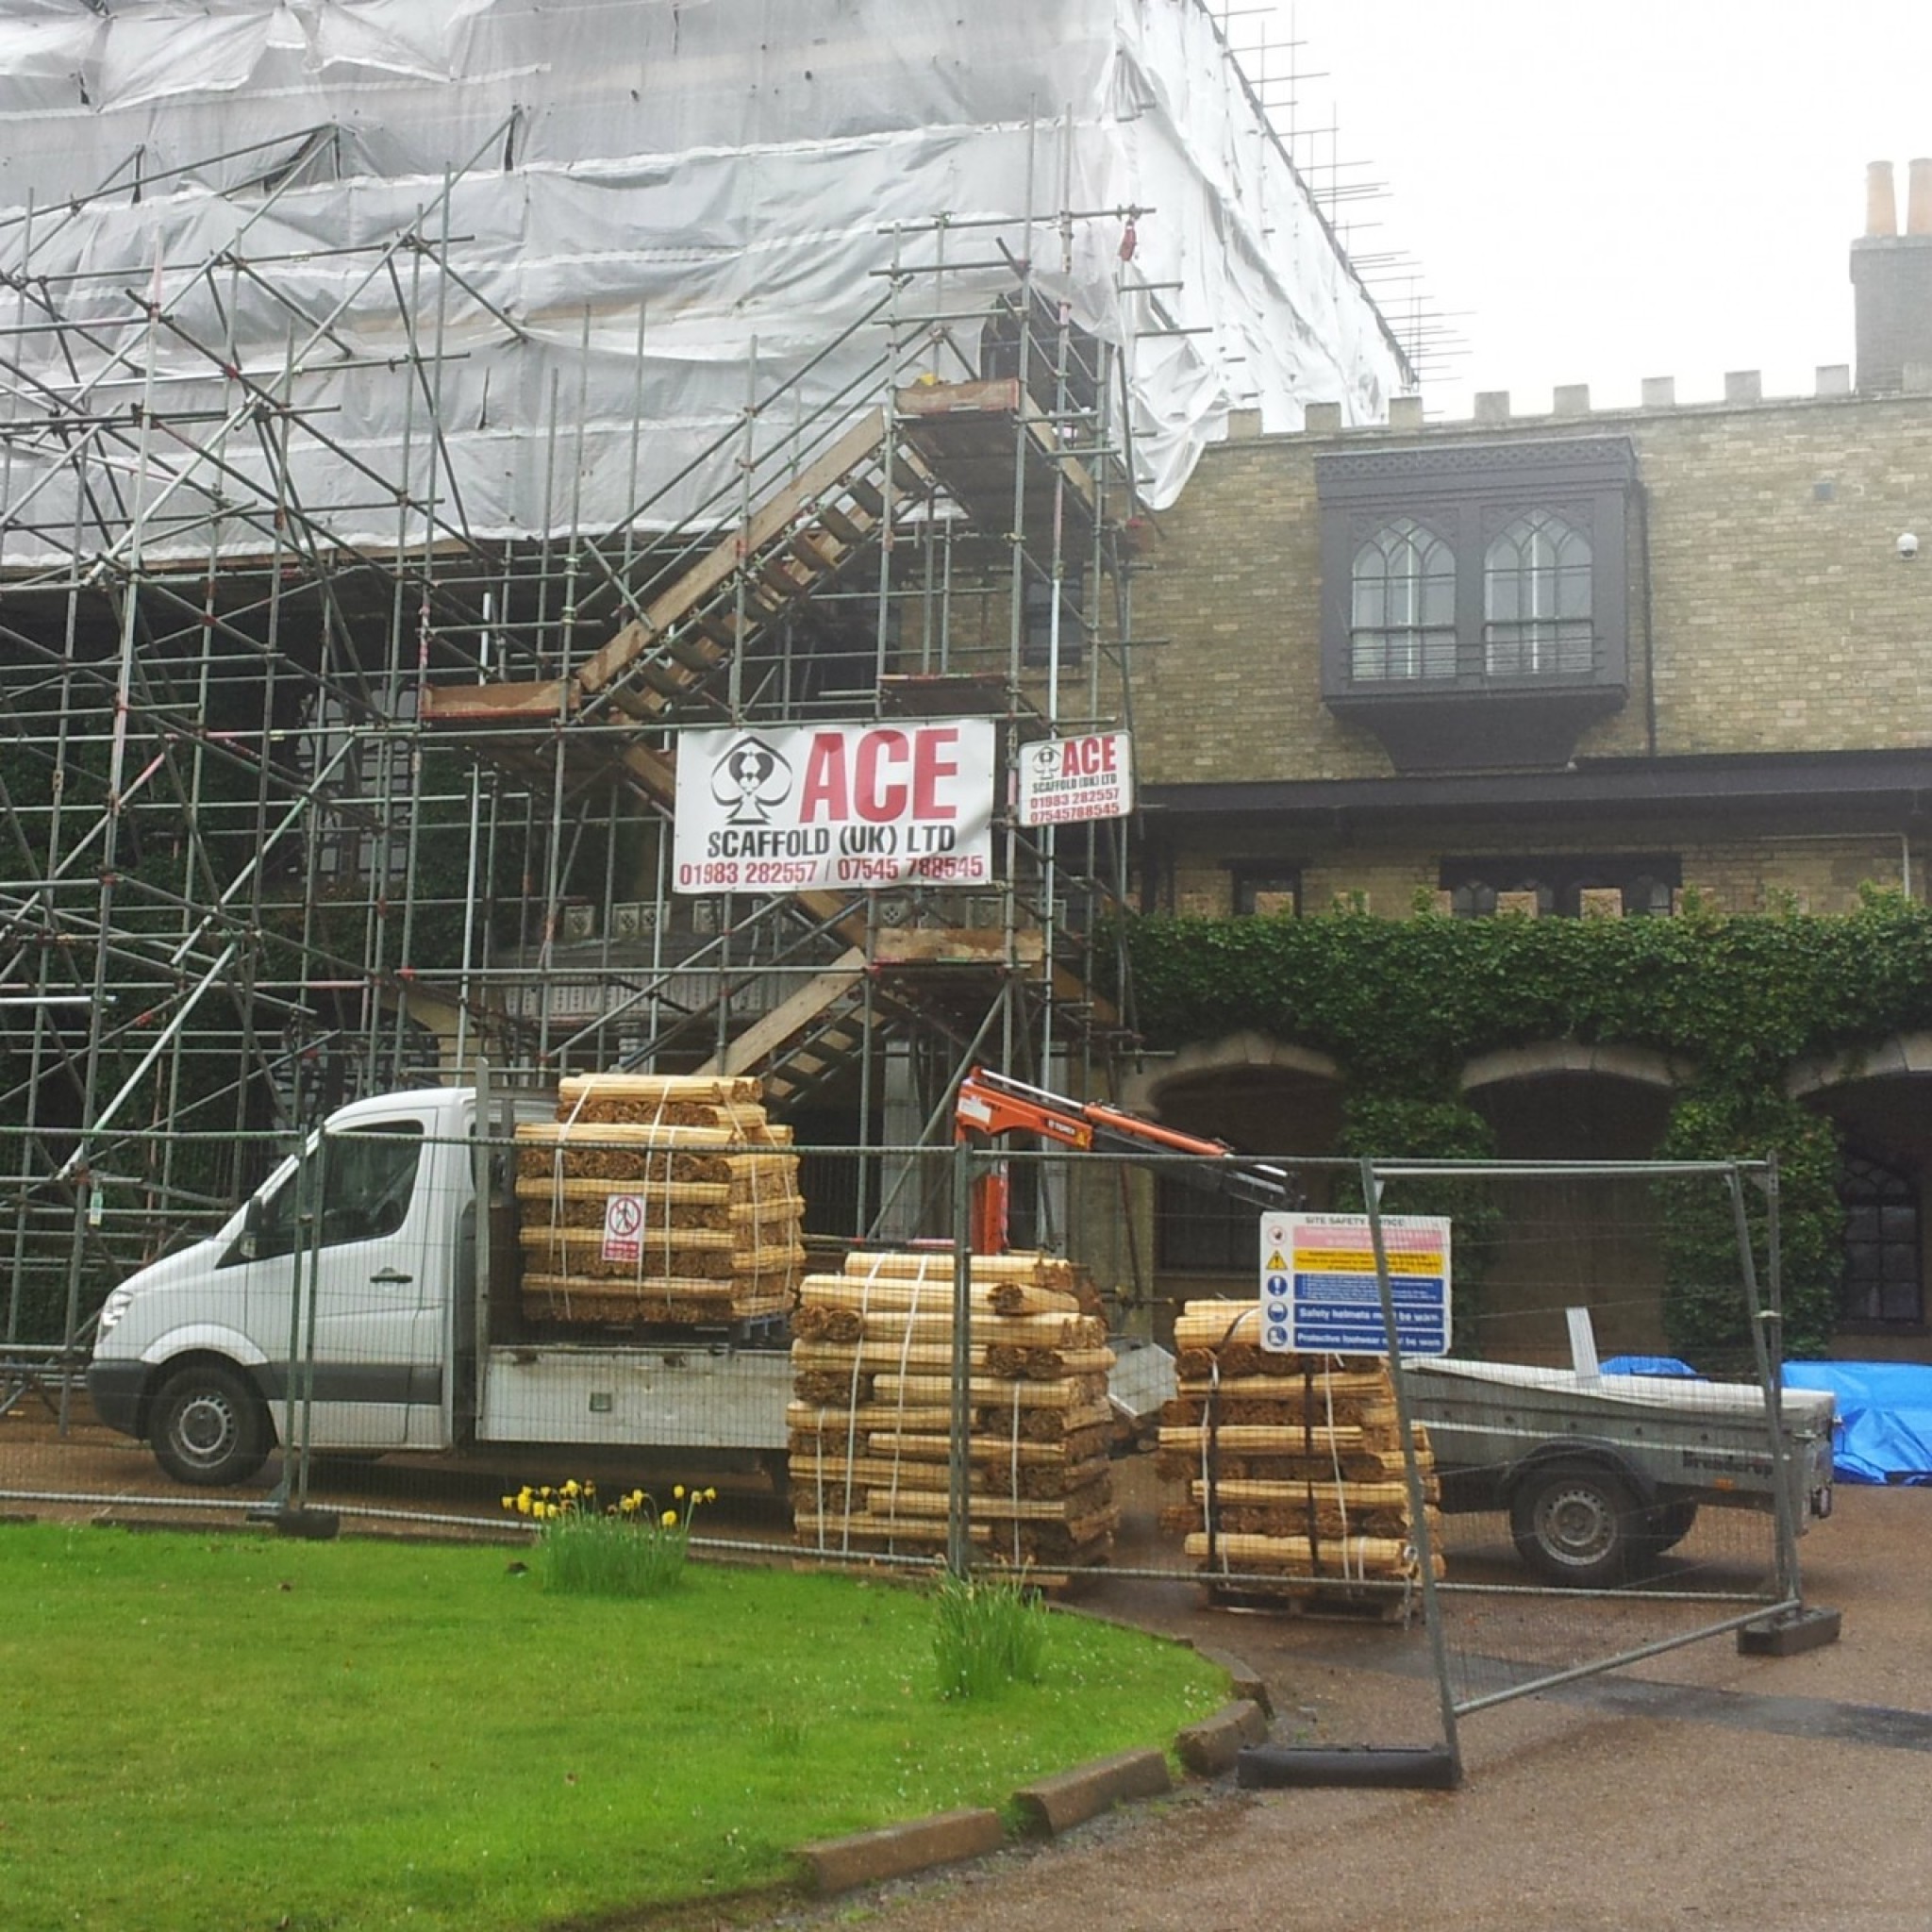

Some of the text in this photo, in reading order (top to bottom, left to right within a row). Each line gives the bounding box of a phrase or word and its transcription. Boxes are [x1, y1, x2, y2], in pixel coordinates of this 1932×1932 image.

[1061, 735, 1116, 777] ACE
[799, 727, 958, 824] ACE
[1032, 778, 1077, 793] SCAFFOLD
[1101, 774, 1117, 786] LTD
[1030, 788, 1120, 808] 01983 282557
[1030, 802, 1120, 824] 07545788545
[707, 825, 955, 858] SCAFFOLD (UK) LTD
[679, 861, 740, 886] 01983
[745, 859, 818, 883] 282557
[837, 857, 899, 881] 07545
[907, 855, 984, 879] 788545
[1305, 1216, 1326, 1224] SITE
[1328, 1217, 1365, 1225] SAFETY
[1299, 1307, 1330, 1321] Safety
[1332, 1308, 1371, 1320] helmets
[1297, 1333, 1341, 1343] Protective
